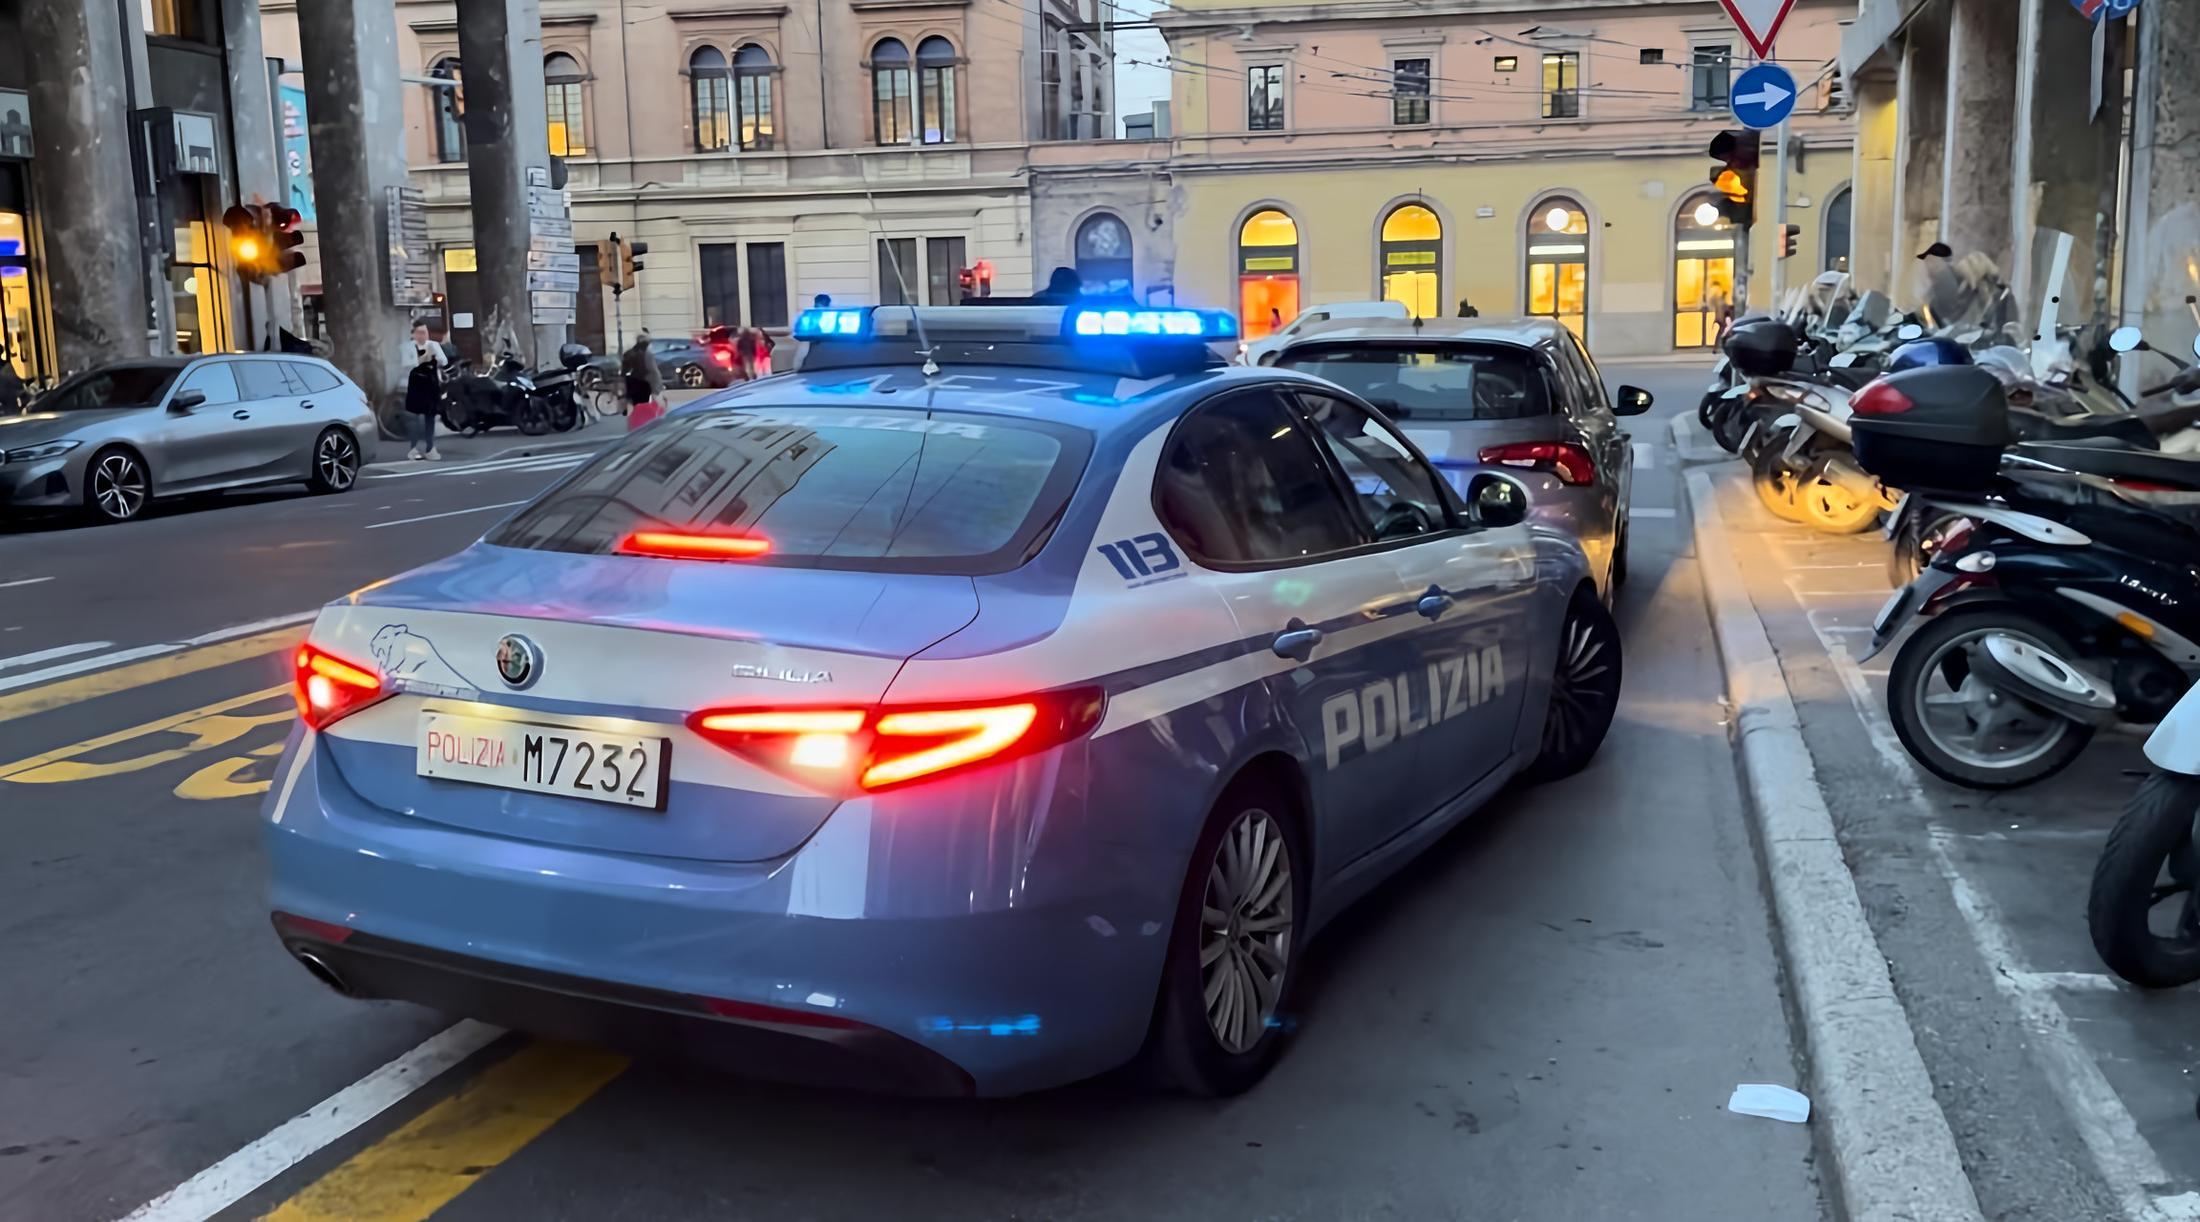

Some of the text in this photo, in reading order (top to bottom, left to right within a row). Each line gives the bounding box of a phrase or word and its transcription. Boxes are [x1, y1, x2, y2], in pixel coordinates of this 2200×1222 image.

[1097, 532, 1180, 580] 113
[1321, 643, 1506, 771] POLIZIA
[428, 731, 647, 798] POLIZIA M7232
